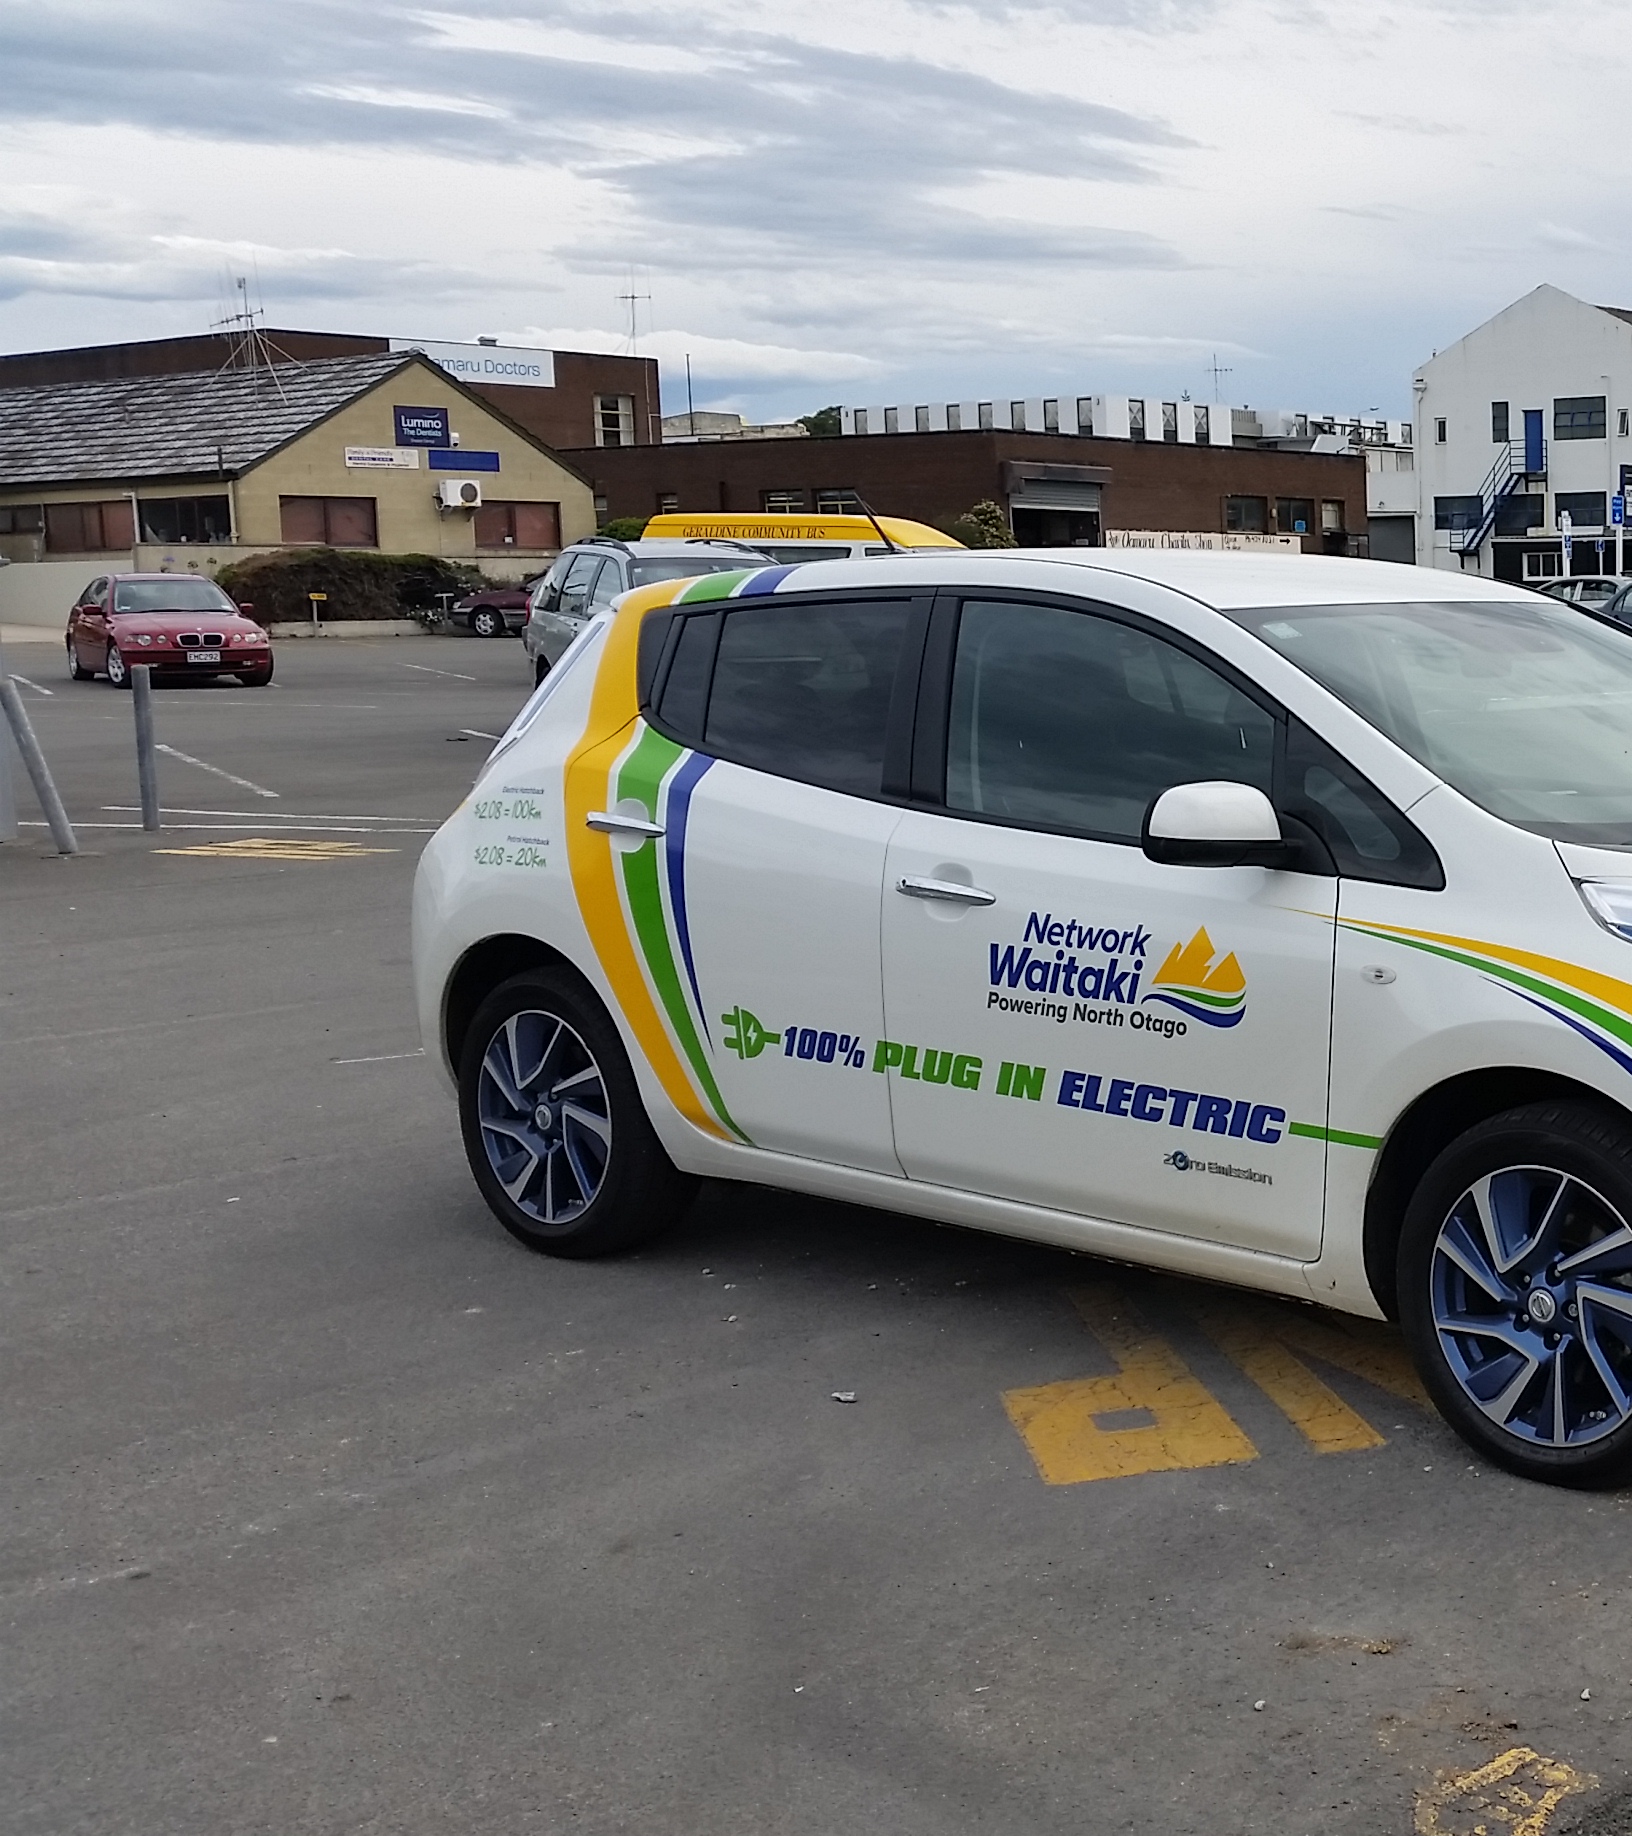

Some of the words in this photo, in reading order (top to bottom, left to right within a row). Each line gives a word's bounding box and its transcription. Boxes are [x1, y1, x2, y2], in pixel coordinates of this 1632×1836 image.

[484, 359, 541, 377] Doctors
[400, 414, 442, 429] Lumino
[402, 427, 416, 436] The
[682, 526, 739, 538] GERALDINE
[741, 526, 802, 539] COMMUNITY
[806, 526, 826, 539] BUS
[1023, 911, 1152, 957] Network
[989, 942, 1144, 1005] Waitaki
[987, 991, 1068, 1023] Powering
[1073, 1003, 1124, 1027] North
[1129, 1010, 1187, 1039] Otago
[784, 1026, 866, 1069] 100%
[872, 1040, 983, 1091] PLUG
[995, 1061, 1047, 1102] IN
[1056, 1069, 1287, 1144] ELECTRIC
[1207, 1162, 1273, 1185] Emission
